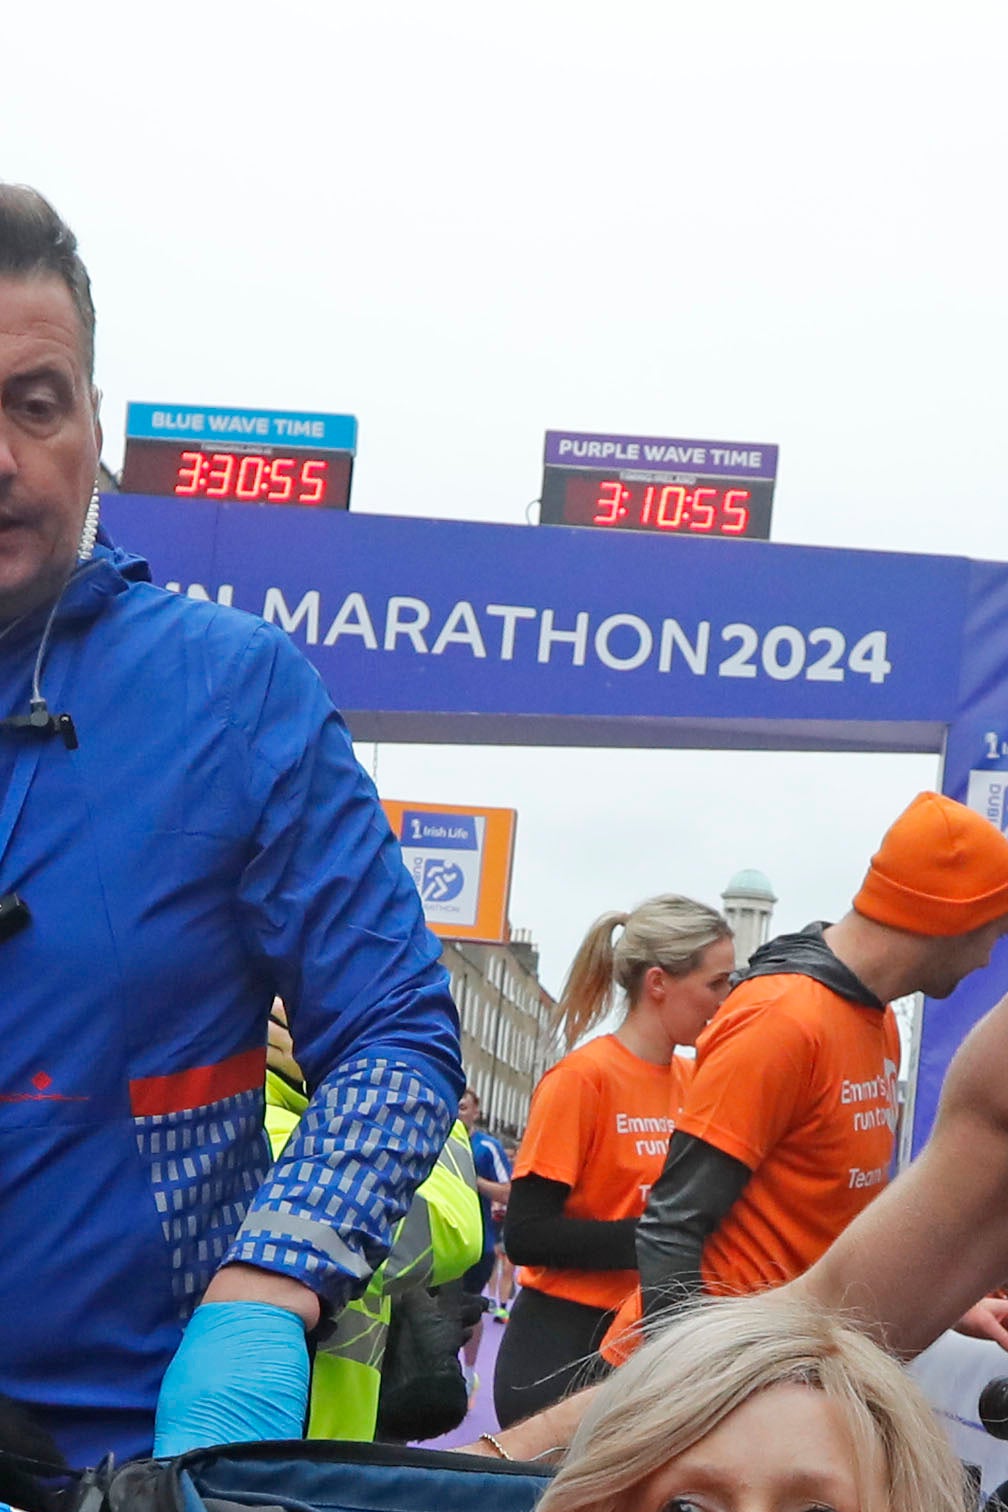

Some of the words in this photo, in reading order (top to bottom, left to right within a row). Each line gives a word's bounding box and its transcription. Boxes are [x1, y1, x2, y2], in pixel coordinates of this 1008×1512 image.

[152, 411, 204, 430] BLUE
[208, 414, 269, 435] WAVE
[273, 418, 325, 438] TIME
[559, 439, 640, 460] PURPLE
[644, 445, 706, 464] WAVE
[710, 449, 762, 468] TIME
[174, 451, 328, 503] 3:30:55
[594, 482, 750, 534] 3:10:55
[423, 825, 446, 837] Irish
[447, 827, 469, 839] Life
